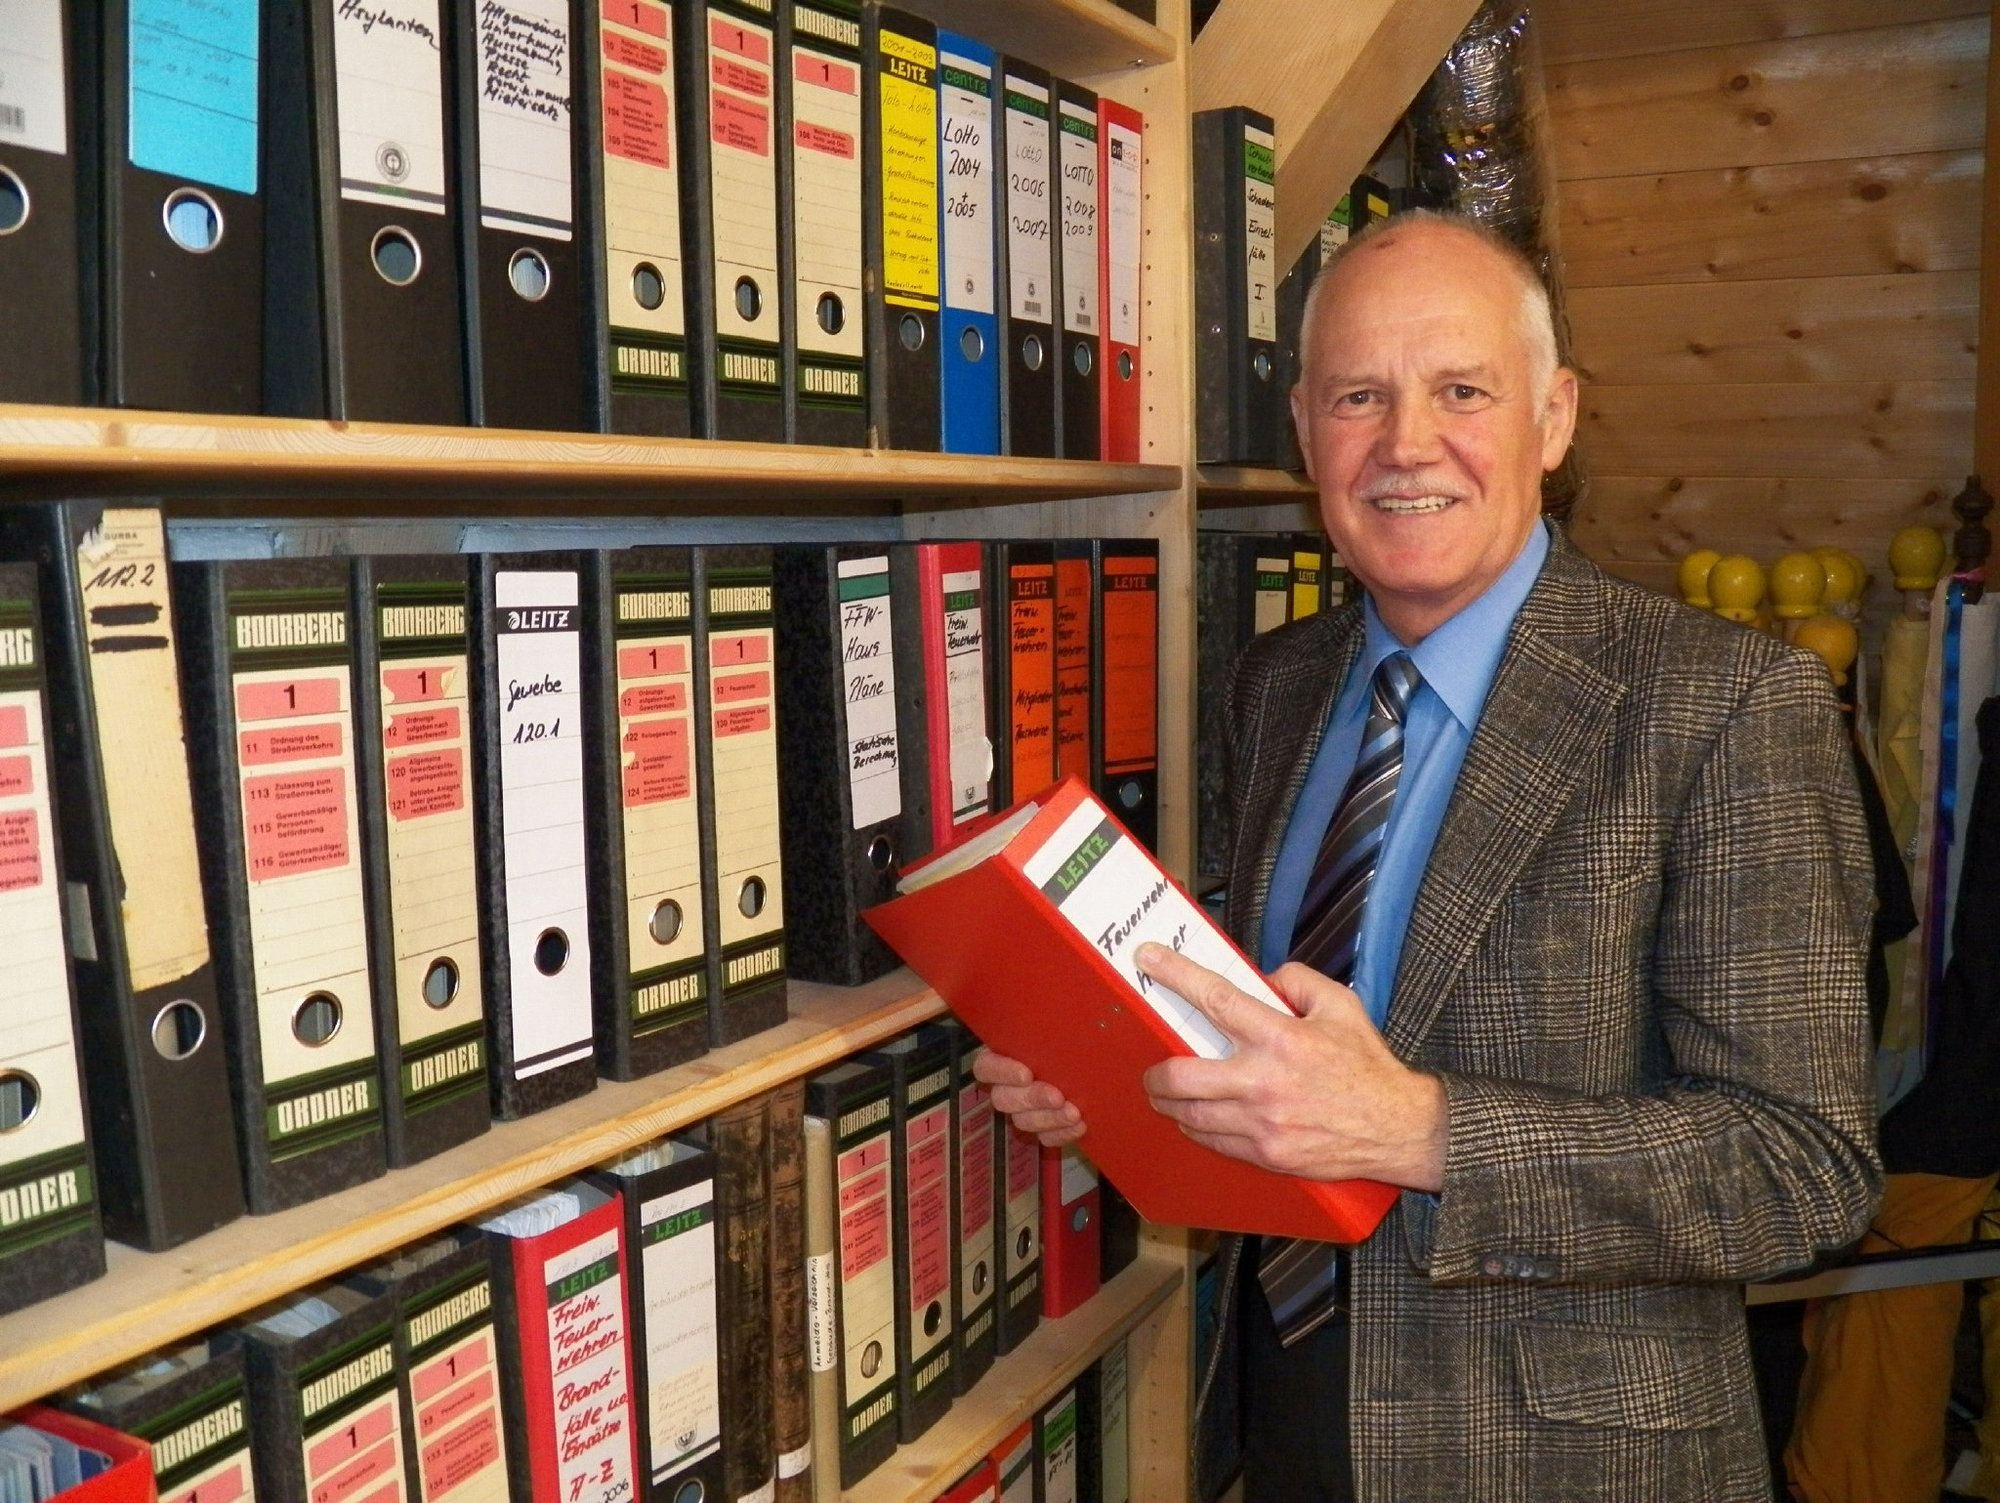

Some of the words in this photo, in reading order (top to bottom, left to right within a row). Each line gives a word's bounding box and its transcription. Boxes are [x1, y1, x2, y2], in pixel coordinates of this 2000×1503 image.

[630, 3, 639, 24] 1
[794, 6, 860, 47] BOORBERG
[736, 31, 743, 51] 1
[821, 64, 829, 82] 1
[890, 58, 927, 84] LEITZ
[945, 69, 988, 93] centra
[1007, 94, 1046, 118] centra
[1063, 116, 1095, 140] centra
[949, 150, 981, 178] 2004
[1011, 174, 1045, 198] 2006
[947, 197, 977, 218] 2005
[1065, 196, 1096, 219] 2008
[1012, 216, 1049, 240] 2007
[1064, 220, 1093, 236] 2009
[617, 346, 680, 378] ORDNER
[724, 353, 776, 384] ORDNER
[804, 368, 859, 396] ORDNER
[1018, 581, 1048, 595] LEITZ
[1114, 576, 1147, 589] LEITZ
[1261, 574, 1284, 588] LEITZ
[1299, 570, 1316, 583] LEITZ
[619, 591, 690, 620] BOORBERG
[710, 586, 771, 613] BOORBERG
[950, 594, 975, 607] LEITZ
[236, 611, 345, 648] BOORBERG
[382, 605, 464, 636] BOORBERG
[521, 610, 570, 629] LEITZ
[648, 649, 657, 669] 1
[736, 640, 744, 659] 1
[845, 637, 881, 661] Haus
[417, 671, 427, 694] 1
[849, 674, 884, 702] Pläne
[283, 684, 295, 709] 1
[623, 698, 632, 707] 12
[270, 735, 304, 745] Ordnung
[388, 728, 397, 737] 12
[513, 717, 561, 744] 120.1
[391, 767, 405, 778] 120
[627, 788, 640, 797] 124
[392, 800, 406, 810] 121
[1056, 832, 1109, 891] LEITZ
[1096, 878, 1169, 957] Feuerwehr
[728, 947, 780, 984] ORDNER
[638, 974, 699, 1014] ORDNER
[411, 1041, 479, 1091] ORDNER
[277, 1080, 369, 1133] ORDNER
[840, 1097, 890, 1137] BOORBERG
[924, 1117, 930, 1132] 1
[859, 1151, 866, 1167] 1
[654, 1209, 703, 1242] LEITZ
[559, 1262, 609, 1299] LEITZ
[410, 1281, 491, 1347] BOORBERG
[965, 1308, 992, 1348] ORDNER
[446, 1356, 455, 1378] 1
[916, 1350, 949, 1391] ORDNER
[302, 1342, 392, 1418] BOORBERG
[557, 1366, 621, 1412] Brand-
[852, 1392, 893, 1437] ORDNER
[346, 1426, 357, 1449] 1
